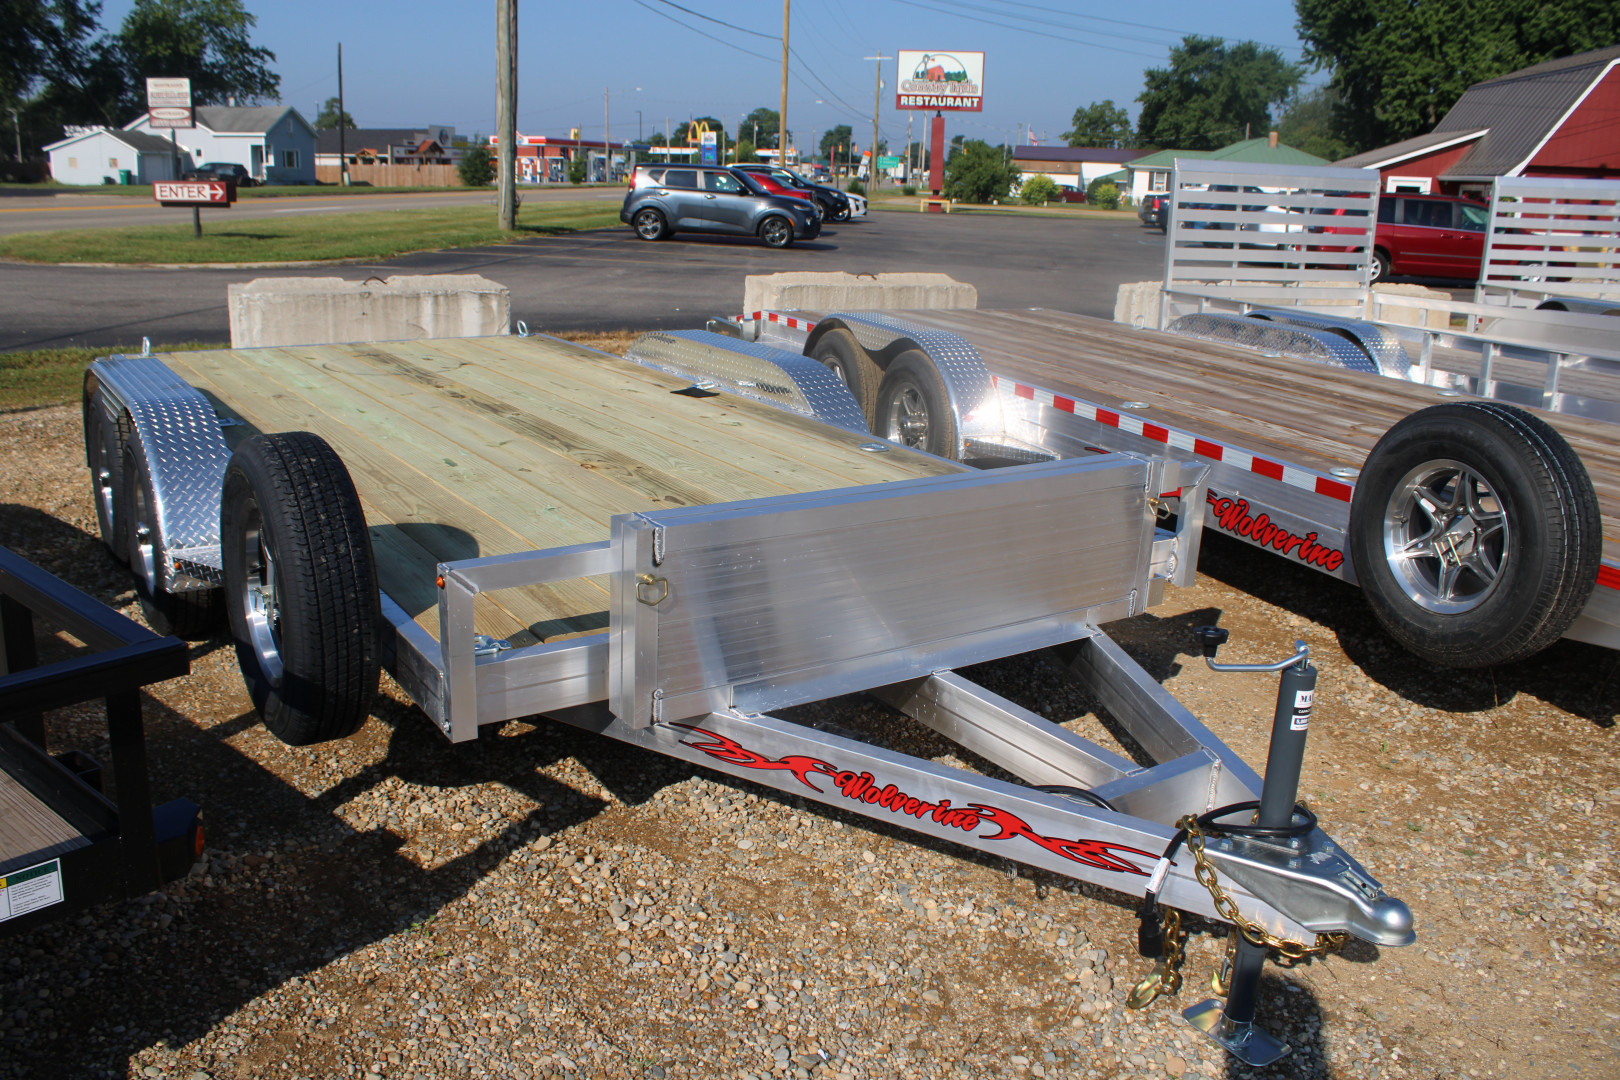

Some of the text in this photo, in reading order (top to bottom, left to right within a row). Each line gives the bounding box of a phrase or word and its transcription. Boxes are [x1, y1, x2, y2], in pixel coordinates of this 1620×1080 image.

[900, 95, 980, 108] RESTAURANT
[160, 185, 208, 199] ENTER
[1213, 497, 1345, 572] Wolverine
[834, 770, 981, 832] Wolverine
